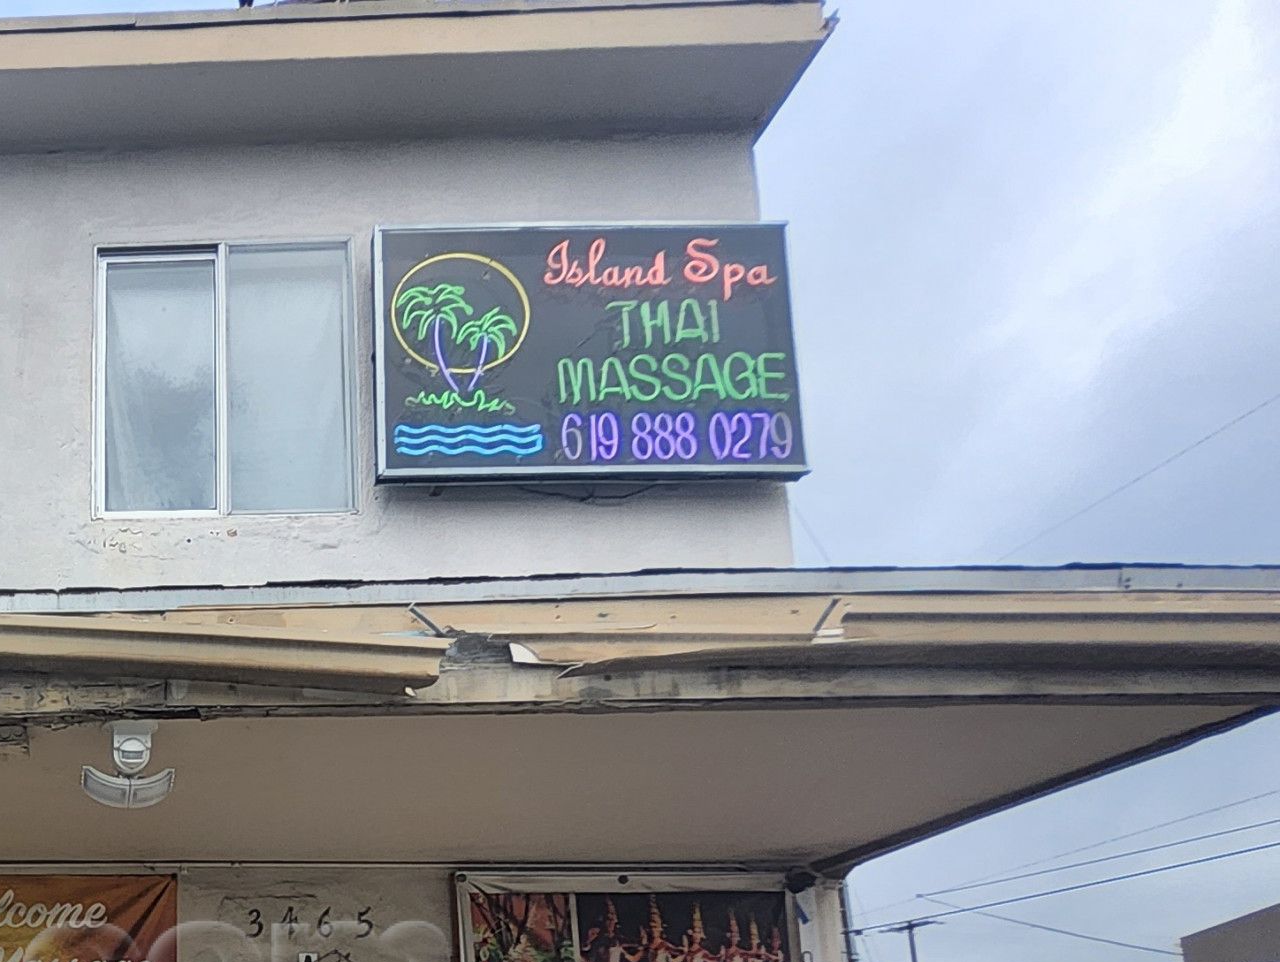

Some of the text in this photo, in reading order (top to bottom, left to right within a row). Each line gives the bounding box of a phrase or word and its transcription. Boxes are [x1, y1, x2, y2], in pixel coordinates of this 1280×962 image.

[543, 238, 778, 301] Island Spa
[605, 298, 719, 348] THAI
[557, 351, 790, 404] MASSAGE
[561, 410, 793, 462] 619 888 0279
[246, 906, 373, 939] 3465
